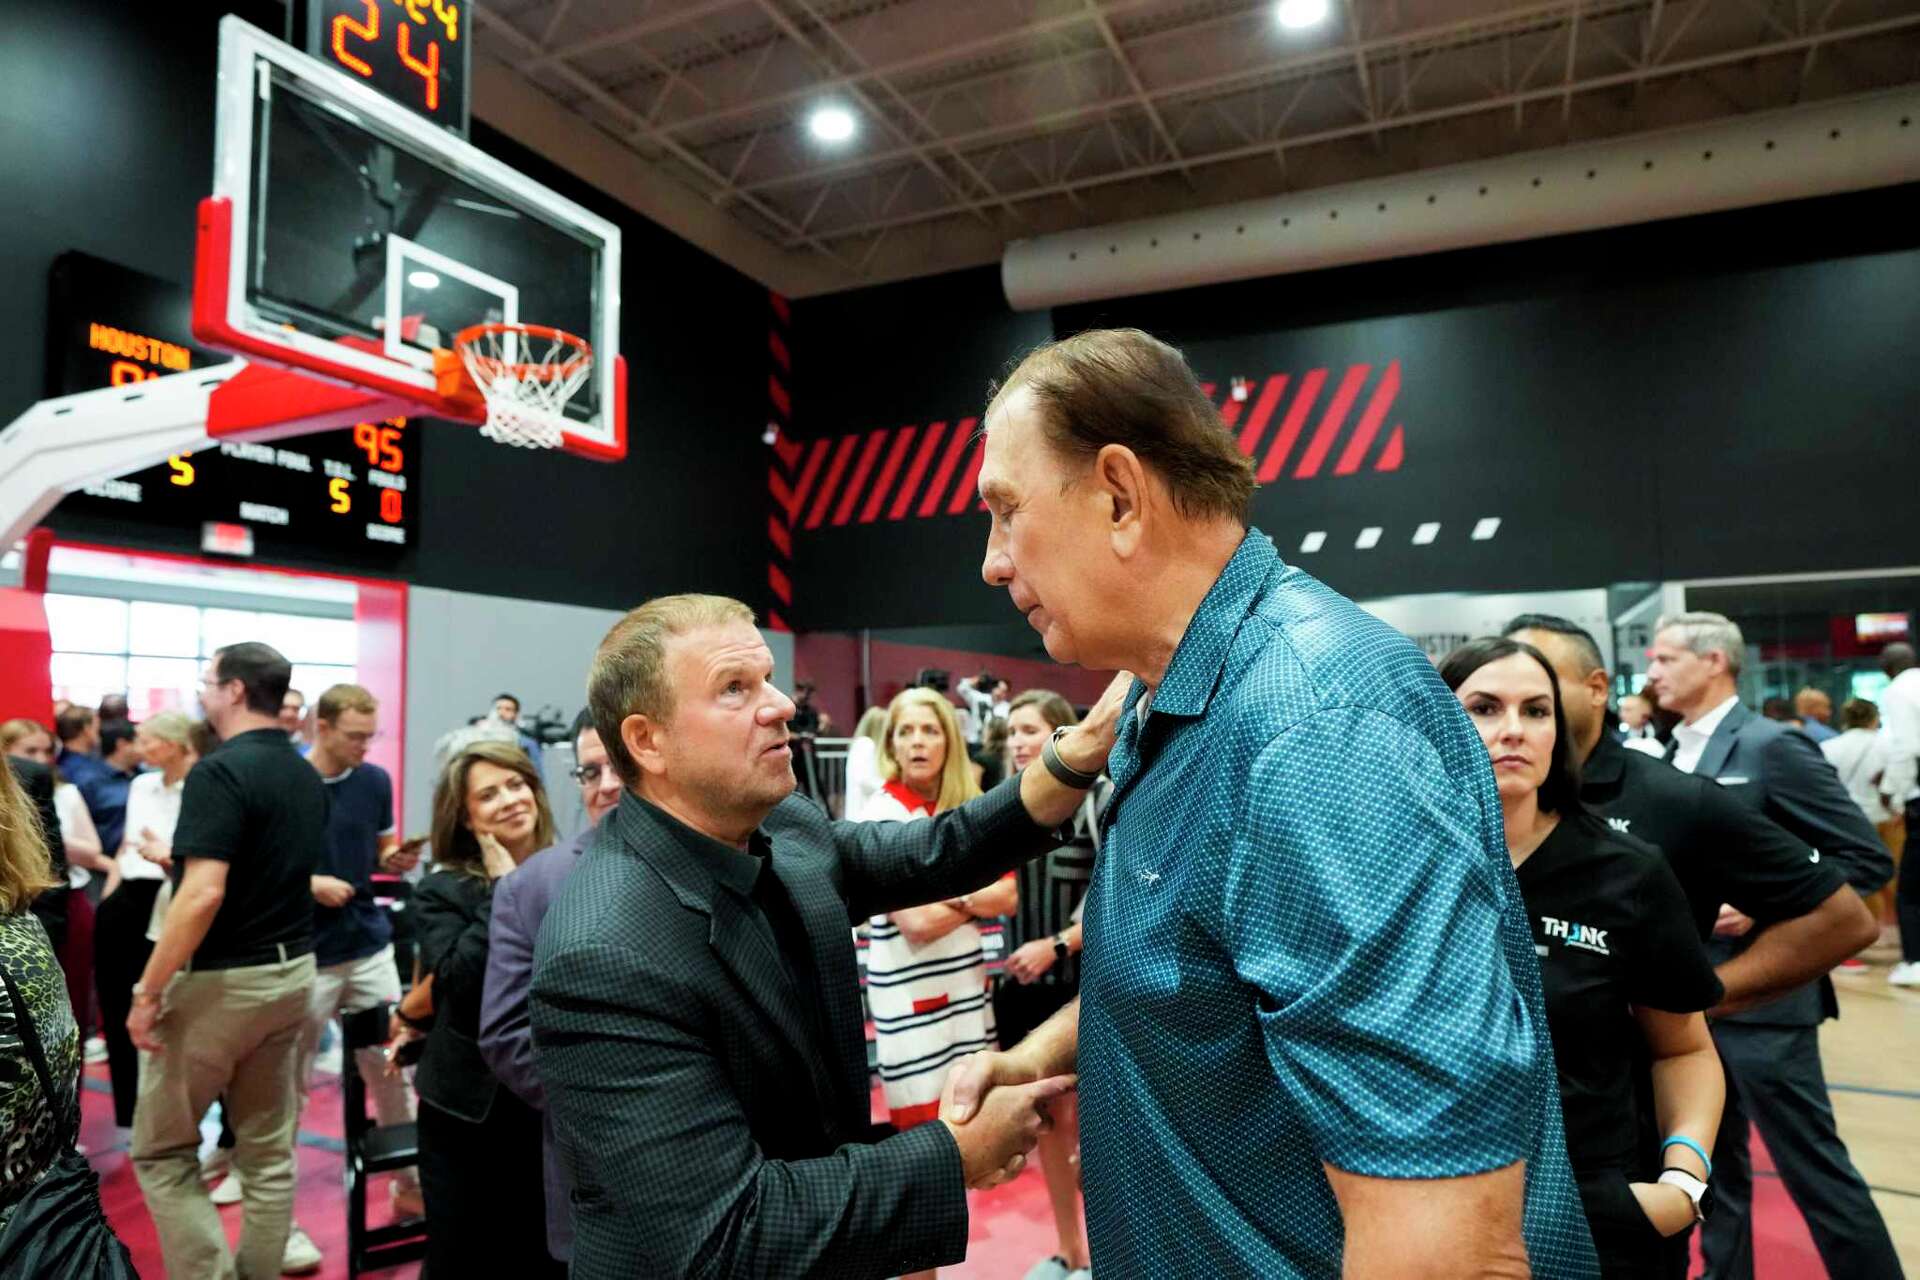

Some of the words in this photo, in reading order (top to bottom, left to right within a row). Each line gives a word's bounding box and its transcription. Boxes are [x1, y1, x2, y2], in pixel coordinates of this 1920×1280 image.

[332, 0, 439, 110] 24
[89, 322, 191, 372] HOUSTON
[353, 422, 404, 474] 95
[329, 477, 351, 514] 5
[380, 486, 402, 523] 0
